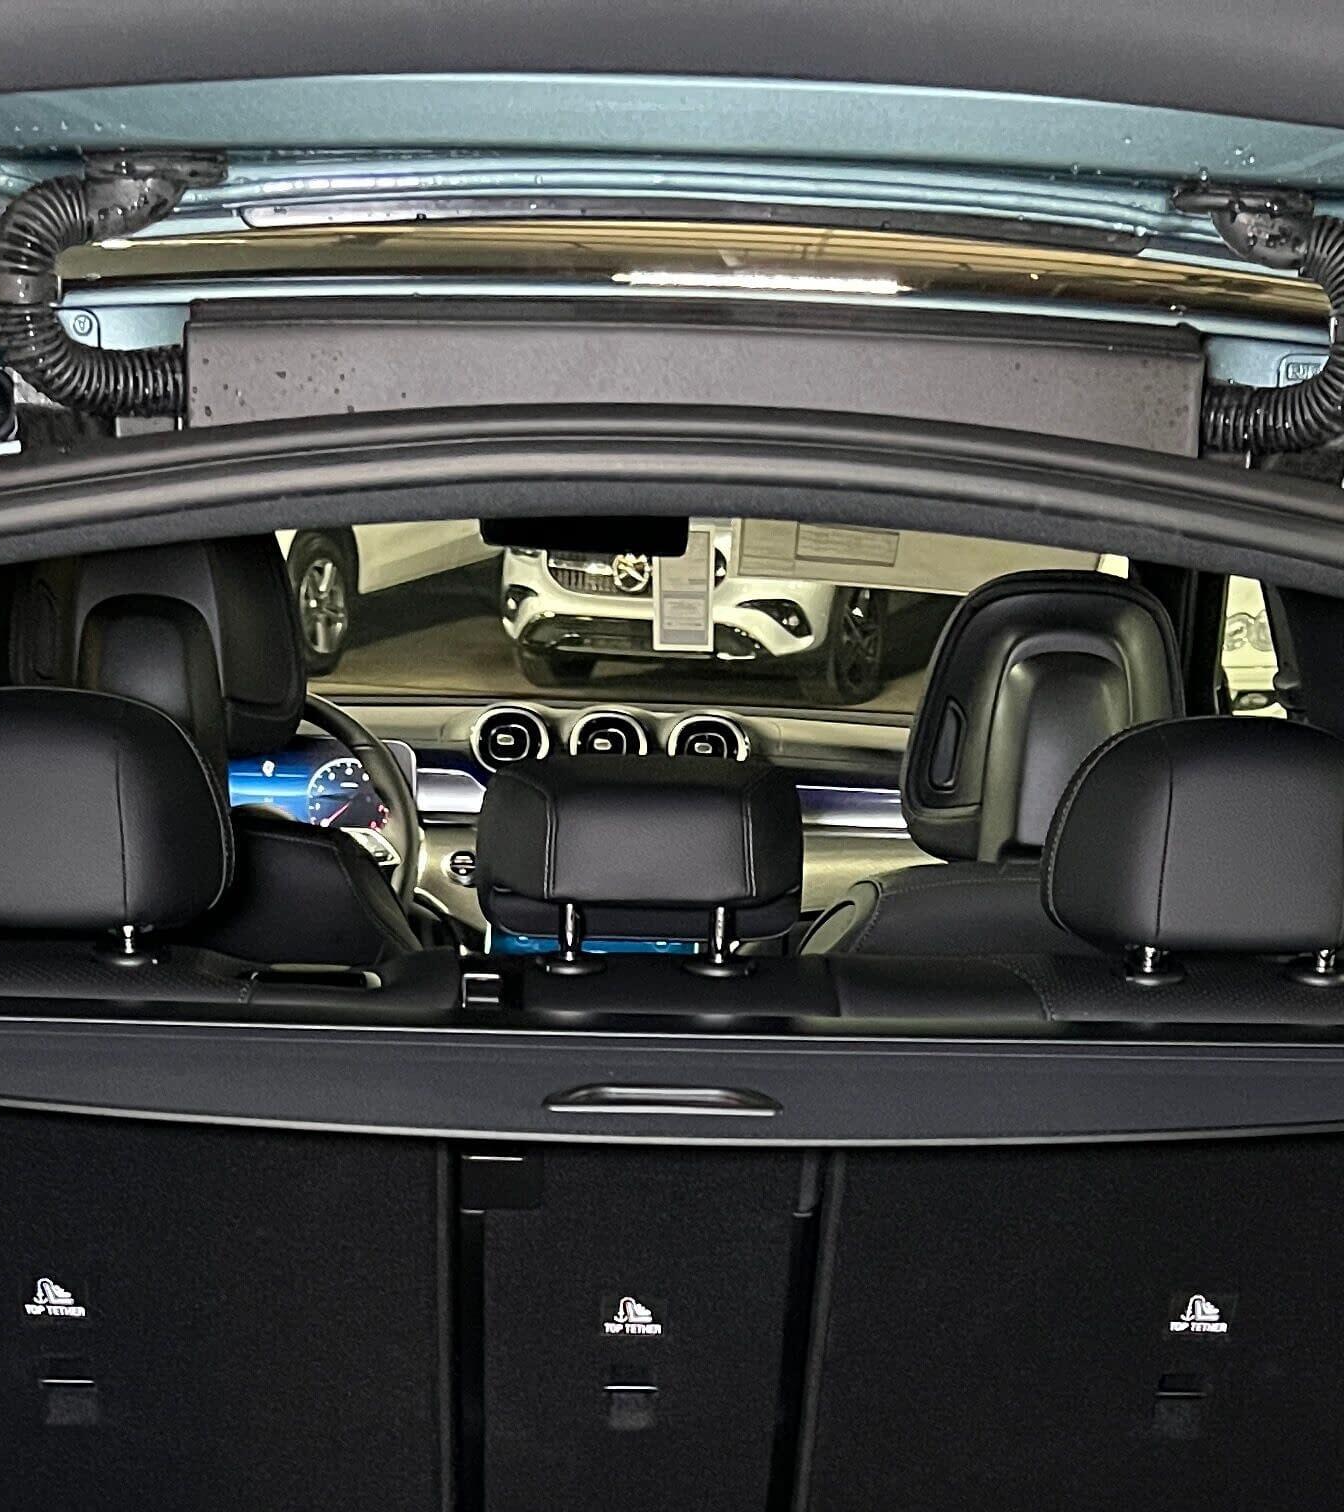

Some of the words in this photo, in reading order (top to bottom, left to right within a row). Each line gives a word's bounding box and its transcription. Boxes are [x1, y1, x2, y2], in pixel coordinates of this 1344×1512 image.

[24, 1304, 45, 1315] TOP
[46, 1305, 85, 1317] TETHER
[604, 1322, 623, 1334] TOP
[625, 1323, 661, 1335] TETHER
[1170, 1321, 1189, 1332] TOP
[1191, 1322, 1227, 1333] TETHER
